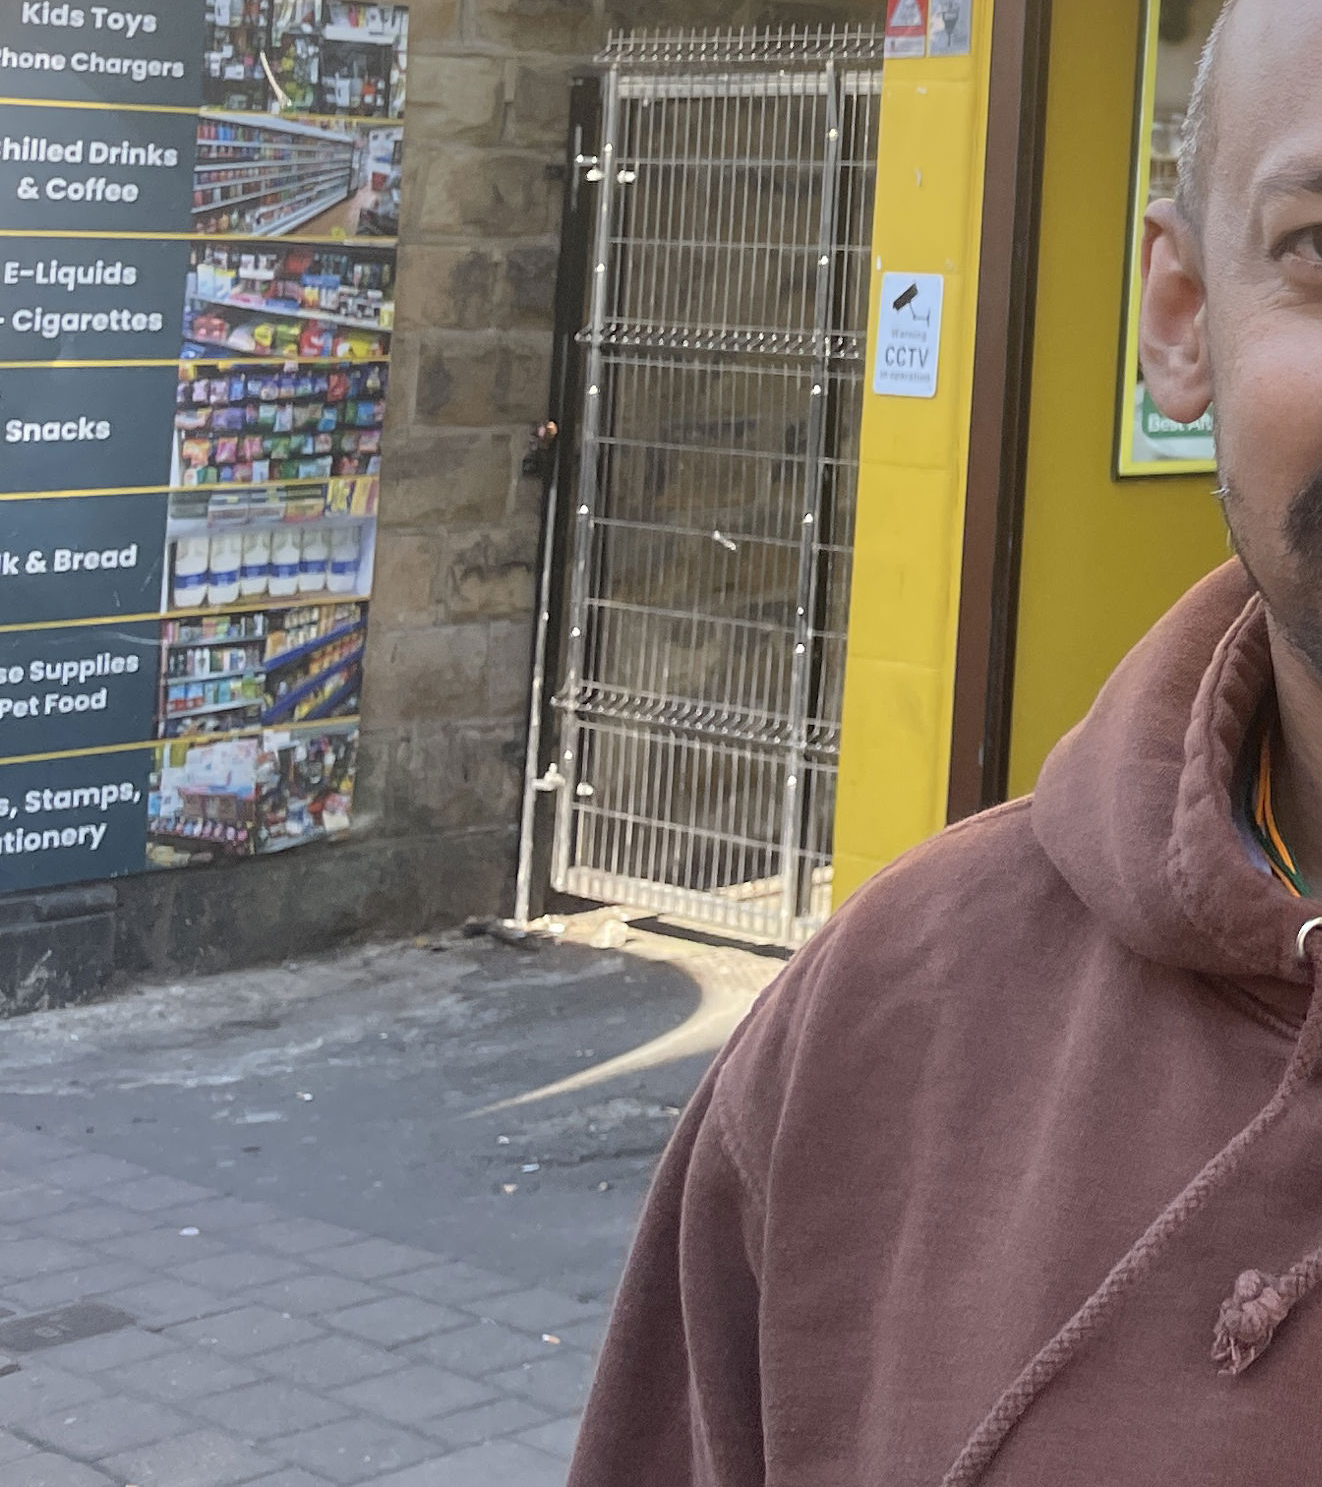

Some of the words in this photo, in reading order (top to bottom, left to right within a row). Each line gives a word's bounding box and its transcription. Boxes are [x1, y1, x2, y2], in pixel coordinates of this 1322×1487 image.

[22, 1, 84, 28] Kids
[91, 7, 157, 37] Toys
[0, 47, 65, 72] hone
[71, 48, 184, 81] Chargers
[0, 136, 83, 163] hilled
[89, 141, 178, 167] Drinks
[17, 179, 39, 201] &
[46, 178, 139, 203] Coffee
[4, 259, 136, 290] E-Liquids
[12, 307, 162, 339] Cigarettes
[885, 347, 929, 368] CCTV
[6, 417, 110, 442] Snacks
[25, 550, 47, 573] &
[54, 544, 137, 571] Bread
[30, 654, 140, 685] Supplies
[0, 696, 39, 718] Pet
[45, 688, 107, 714] Food
[25, 782, 141, 813] Stamps,
[0, 821, 106, 854] tionery
